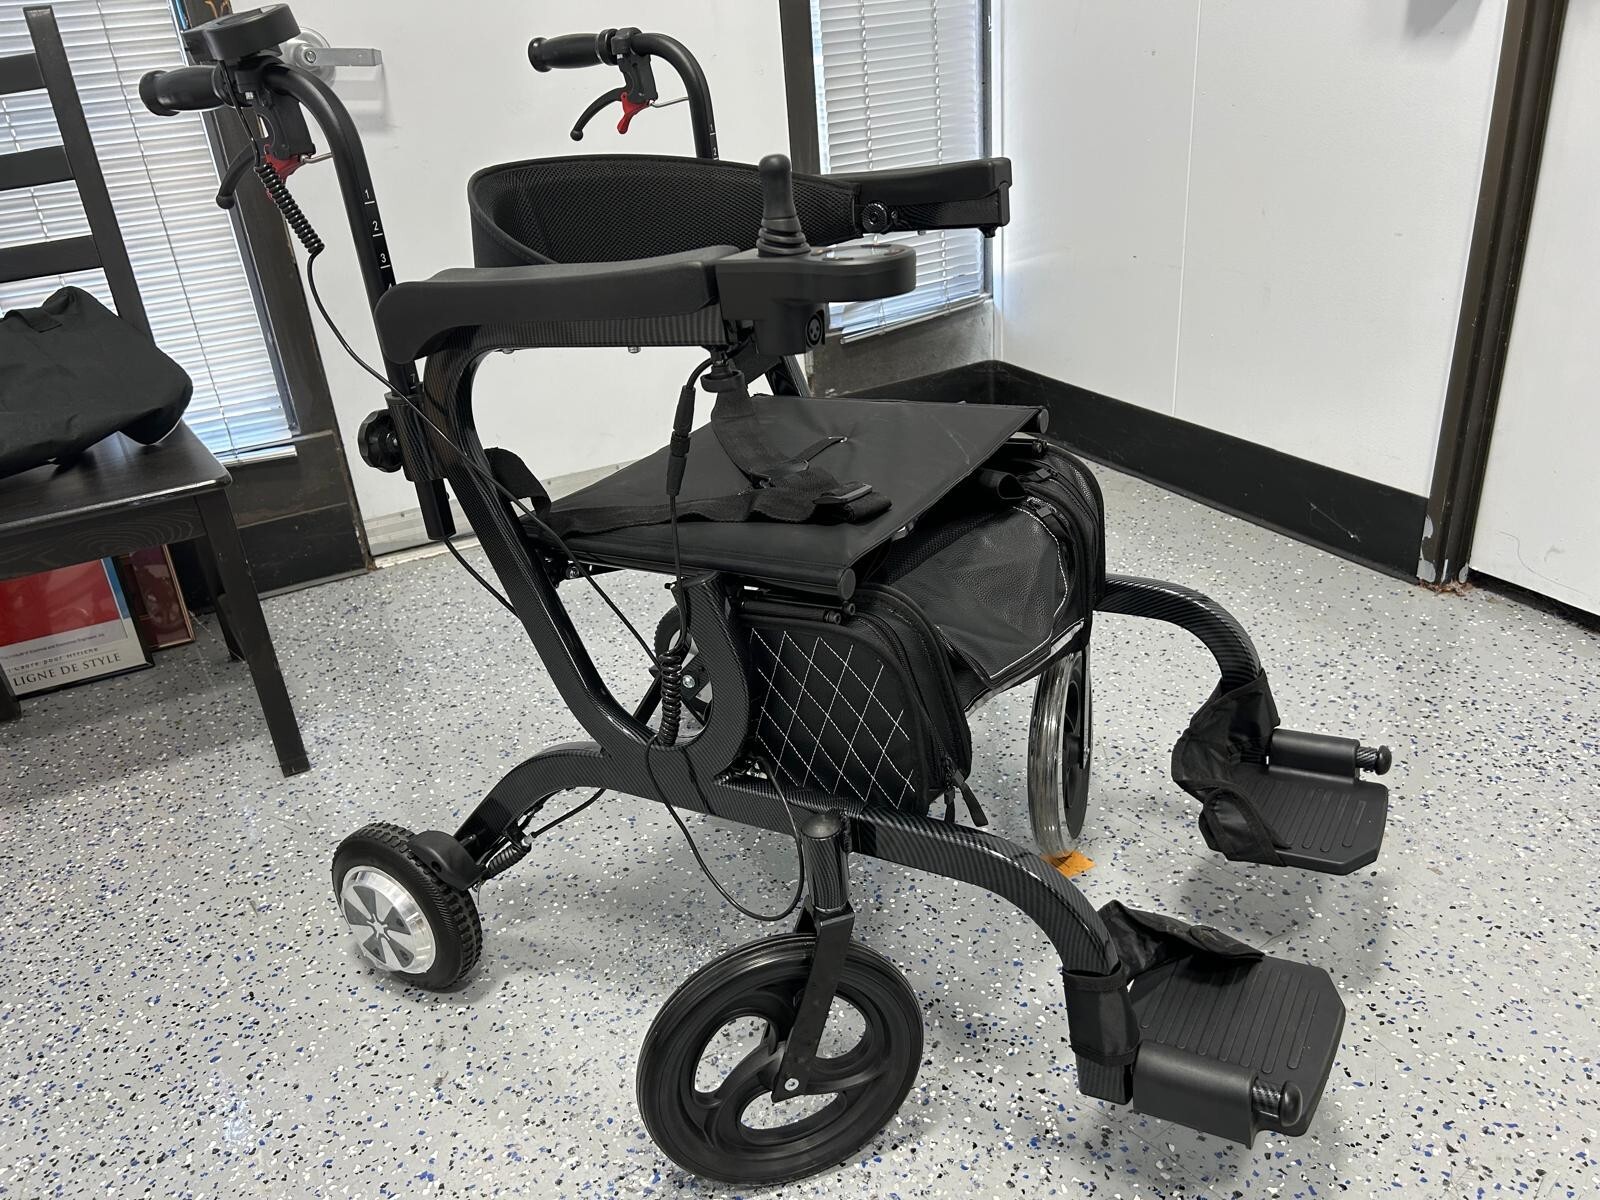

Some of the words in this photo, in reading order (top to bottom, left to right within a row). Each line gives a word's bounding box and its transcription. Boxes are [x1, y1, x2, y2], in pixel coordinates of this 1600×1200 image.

[713, 147, 717, 156] 2
[365, 189, 370, 199] 1
[372, 220, 379, 231] 2
[380, 253, 387, 263] 3
[410, 373, 416, 383] 7
[13, 670, 57, 687] LIGNE
[60, 663, 80, 676] DE
[82, 653, 121, 670] STYLE
